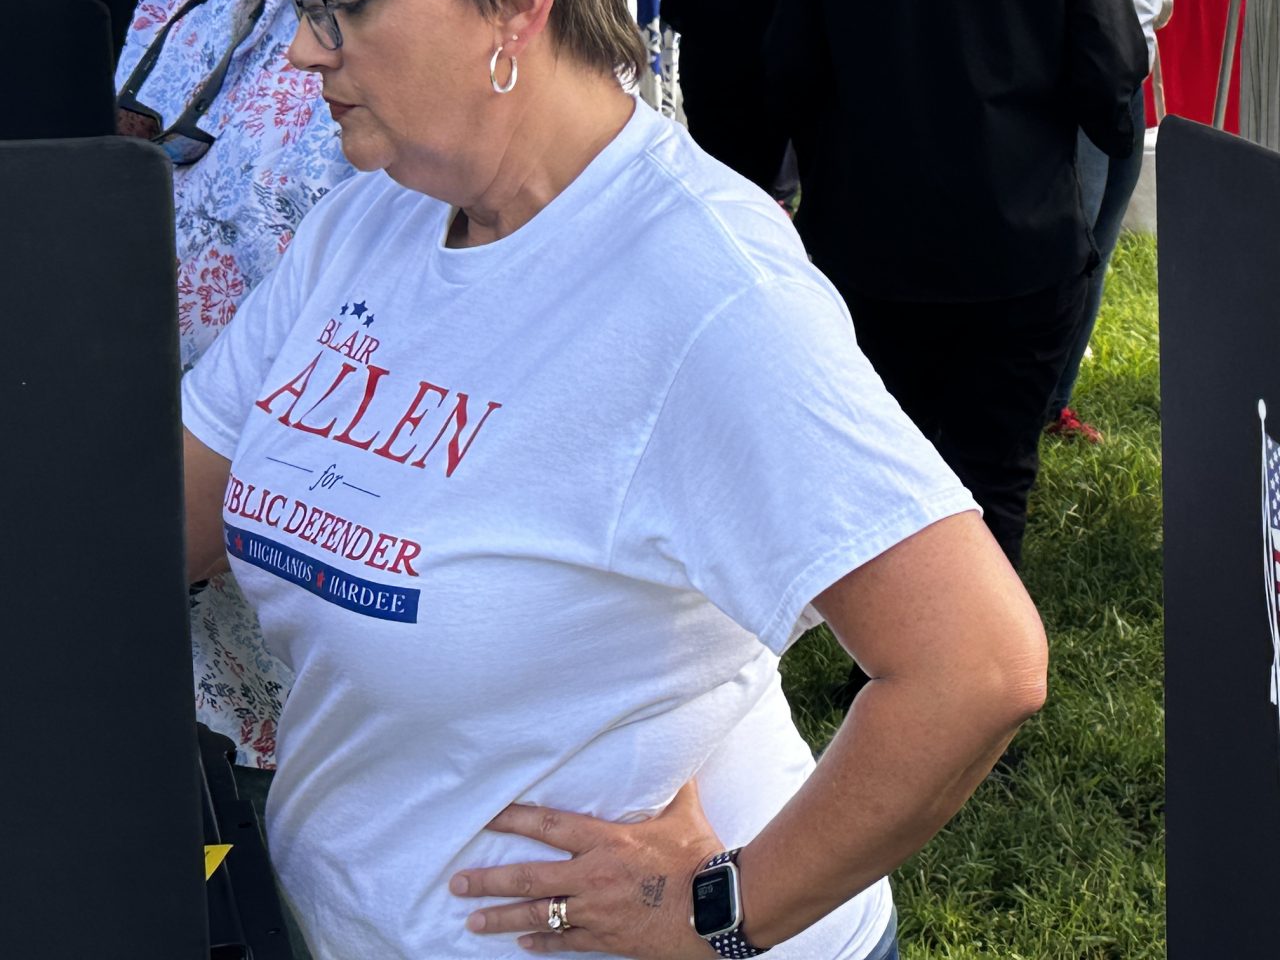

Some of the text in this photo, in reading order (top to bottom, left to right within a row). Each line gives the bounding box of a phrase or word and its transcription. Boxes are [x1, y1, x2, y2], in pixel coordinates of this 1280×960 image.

[316, 318, 381, 366] BLAIR
[255, 350, 503, 478] ALLEN
[308, 463, 346, 492] for
[282, 500, 422, 577] DEFENDER
[248, 539, 406, 614] HIGHLANDS HARDEE
